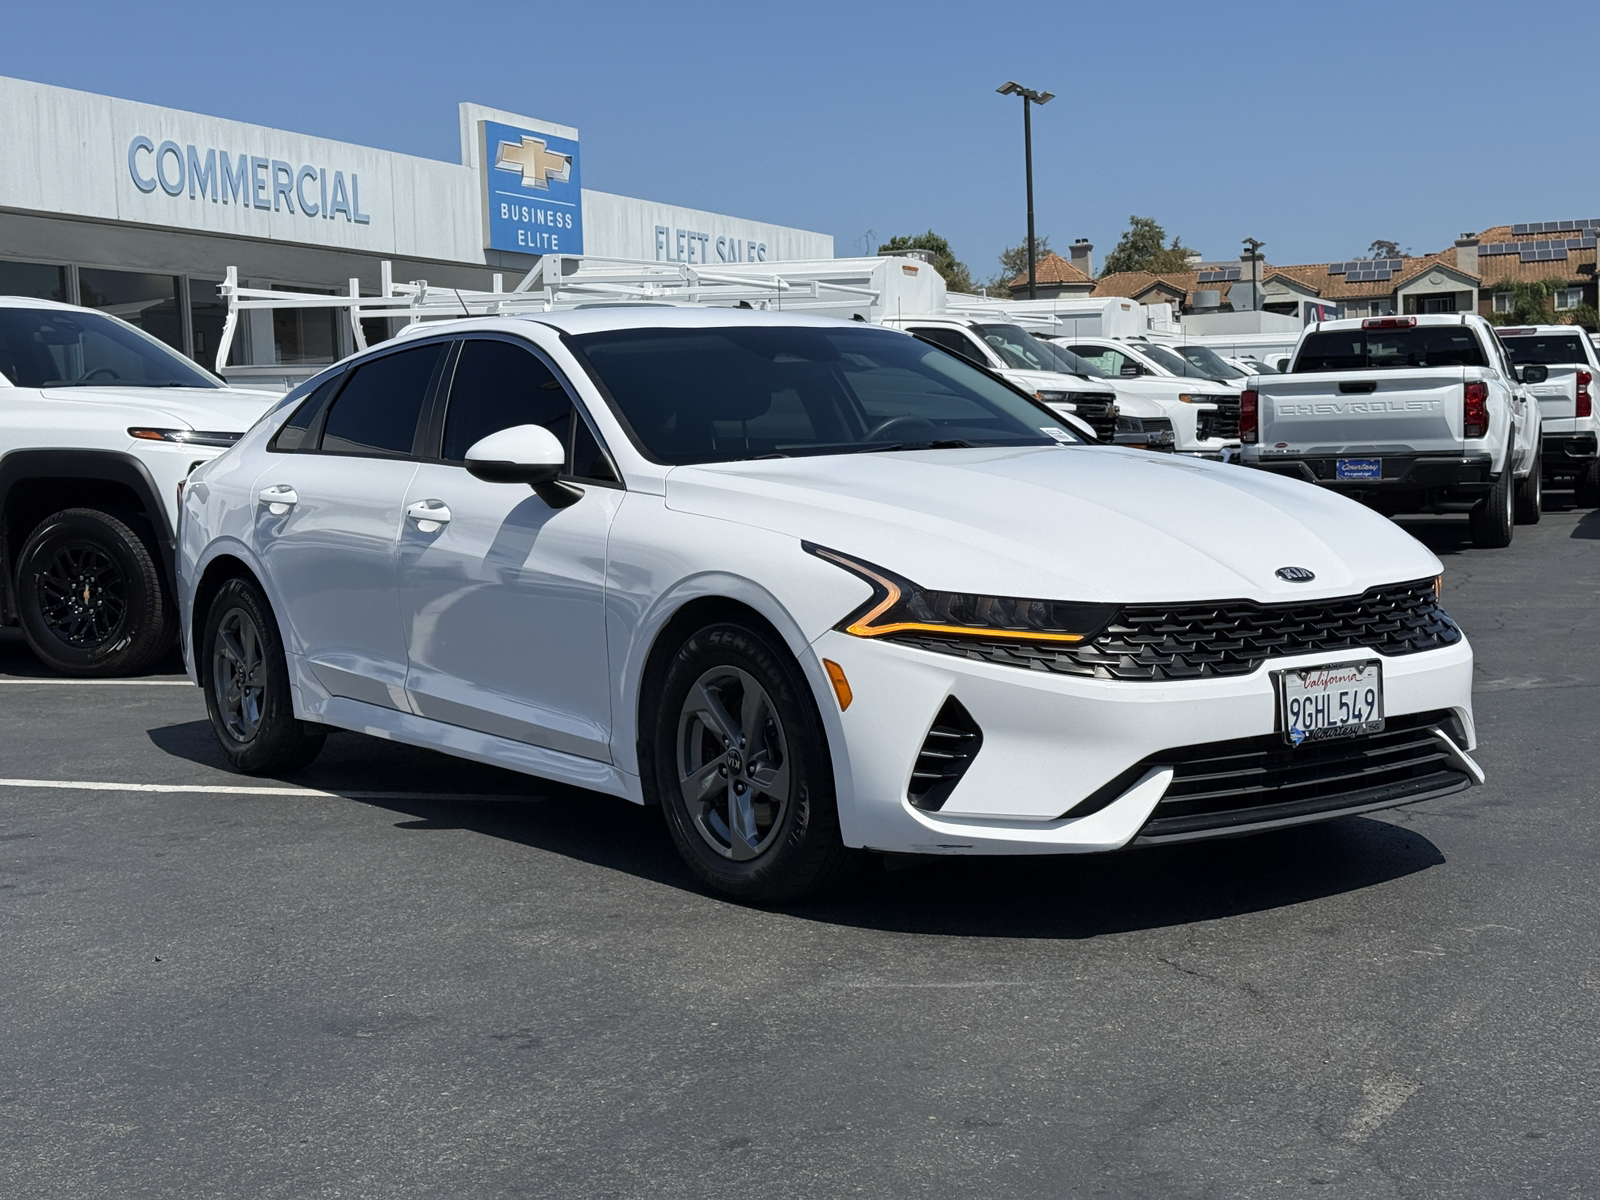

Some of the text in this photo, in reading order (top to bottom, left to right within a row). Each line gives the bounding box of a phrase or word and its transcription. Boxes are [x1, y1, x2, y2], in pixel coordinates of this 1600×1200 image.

[128, 135, 370, 225] COMMERCIAL
[501, 203, 572, 230] BUSINESS
[518, 230, 559, 250] ELITE
[655, 225, 767, 264] FLEET SALES
[1278, 400, 1440, 417] CHEVROLET
[1341, 463, 1379, 472] Courtesy
[1280, 568, 1313, 579] KIA
[1303, 670, 1363, 691] California
[1290, 688, 1375, 729] 9GHL549
[1313, 725, 1361, 740] Courtesy
[727, 756, 741, 770] KIA
